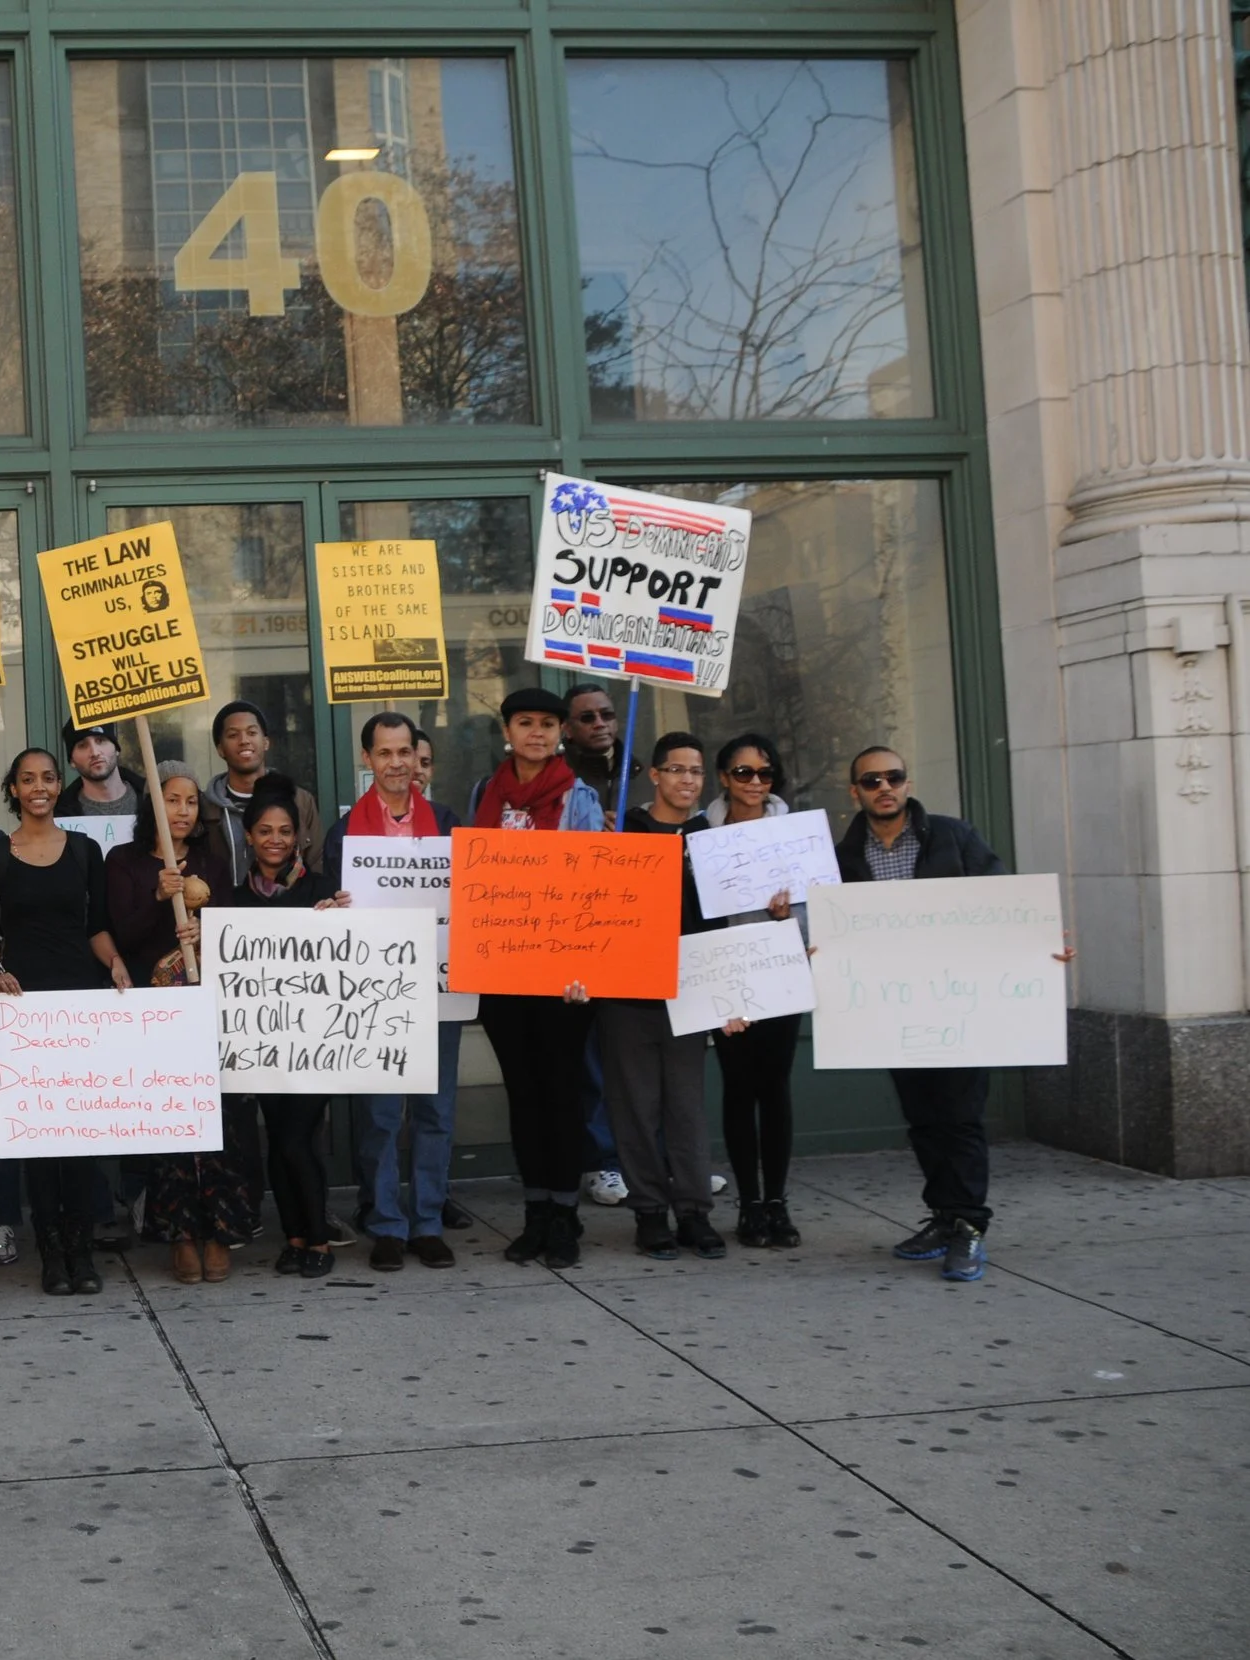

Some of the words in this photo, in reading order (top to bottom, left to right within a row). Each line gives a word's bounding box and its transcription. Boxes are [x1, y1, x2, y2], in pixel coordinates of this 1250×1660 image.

[173, 169, 433, 318] 40
[63, 554, 100, 577] THE
[104, 536, 150, 566] LAW
[352, 545, 368, 557] WE
[378, 544, 402, 556] ARE
[60, 563, 167, 601] CRIMINALIZES
[332, 564, 392, 578] SISTERS
[402, 564, 426, 576] AND
[553, 549, 722, 609] SUPPORT
[348, 584, 415, 597] BROTHERS
[104, 597, 132, 614] US,
[336, 606, 351, 618] OF
[363, 604, 387, 616] THE
[397, 603, 428, 616] SAME
[72, 618, 182, 660] STRUGGLE
[329, 624, 396, 640] ISLAND
[542, 605, 652, 647] DOMINICAN
[112, 652, 150, 672] WILL
[74, 664, 164, 701] ABSOLVE
[168, 656, 199, 678] US
[79, 680, 200, 719] ANSWERCoalition.org
[105, 823, 115, 842] A
[377, 876, 416, 888] CON
[420, 876, 450, 888] LOS
[462, 883, 532, 910] Defending
[538, 884, 563, 901] the
[571, 884, 611, 909] right
[622, 888, 638, 904] to
[546, 914, 568, 931] for
[574, 912, 642, 932] Dominicans
[219, 924, 370, 966] Caminando
[378, 940, 416, 966] en
[497, 938, 542, 954] Haitian
[688, 936, 772, 968] SUPPORT
[218, 966, 330, 998] Protesta
[339, 970, 418, 1003] Desde
[142, 1010, 182, 1036] por
[323, 999, 380, 1040] 207
[376, 1046, 408, 1076] 44
[112, 1068, 133, 1088] el
[142, 1069, 216, 1088] derecho
[18, 1100, 28, 1112] a
[38, 1094, 54, 1112] la
[162, 1096, 186, 1112] de
[193, 1098, 216, 1112] los
